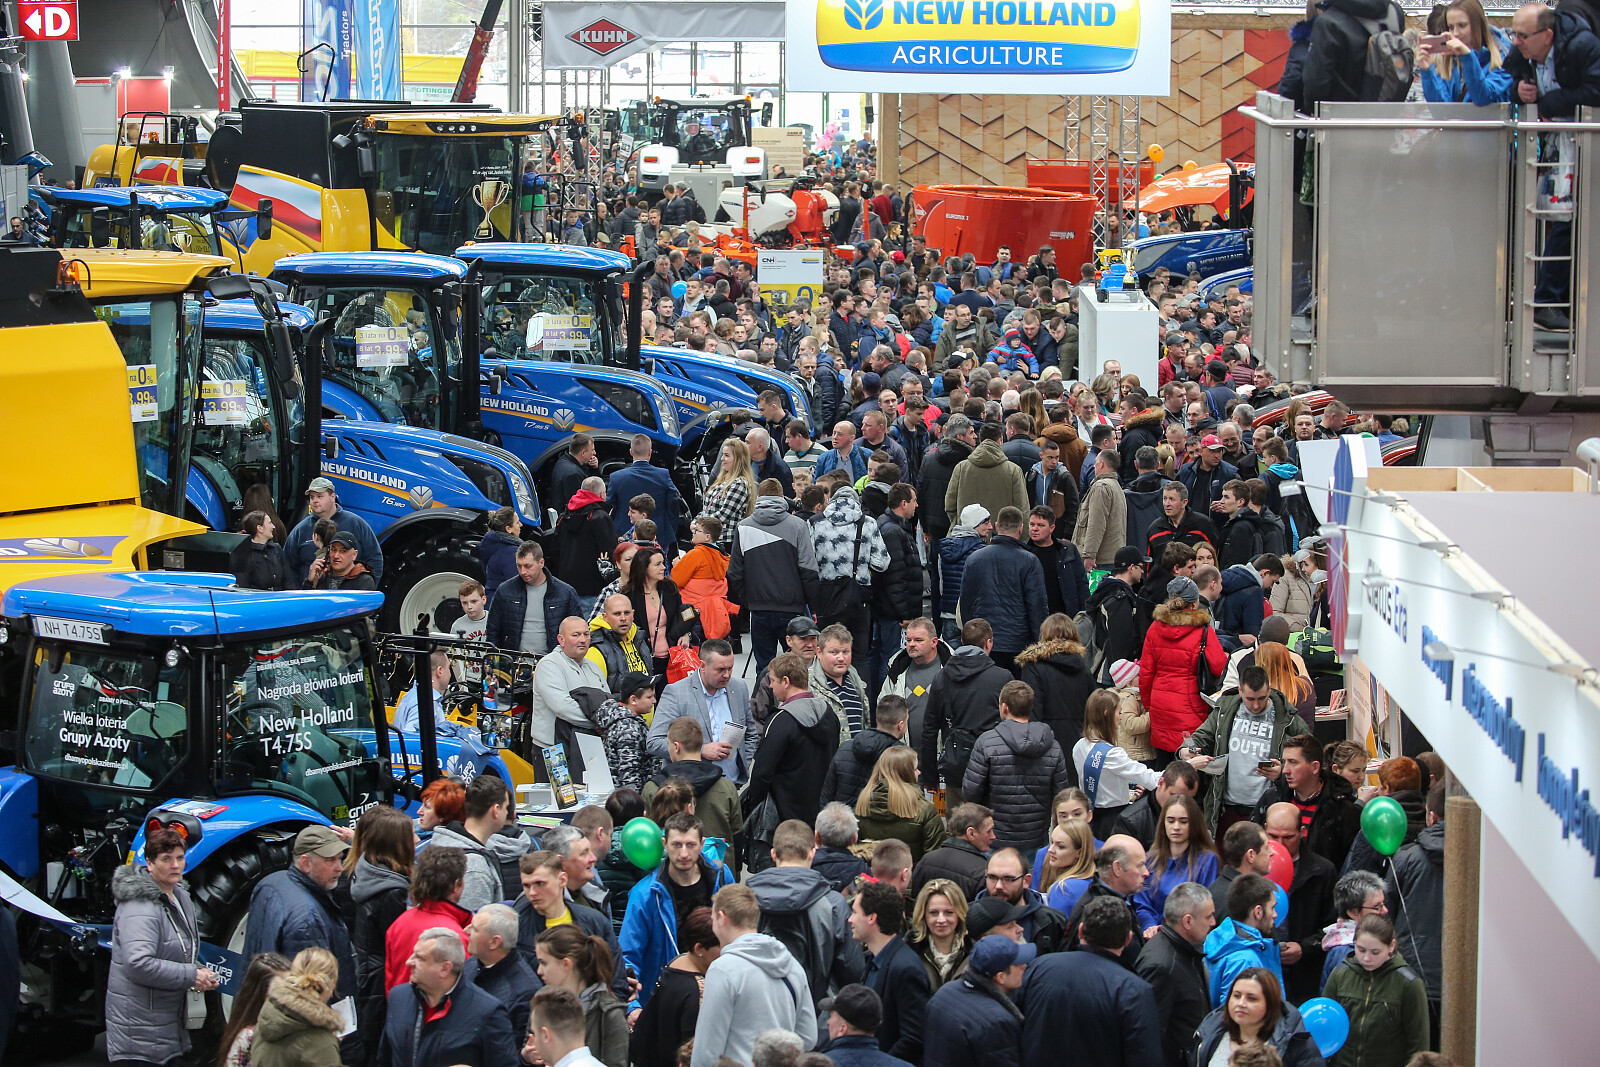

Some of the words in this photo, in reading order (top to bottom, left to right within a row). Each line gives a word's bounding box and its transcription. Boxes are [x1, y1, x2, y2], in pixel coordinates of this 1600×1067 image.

[44, 6, 70, 37] D
[893, 0, 965, 25] NEW
[972, 0, 1117, 27] HOLLAND
[340, 10, 352, 60] Tractors
[579, 31, 628, 43] KUHN
[891, 46, 1064, 66] AGRICULTURE
[572, 315, 587, 327] 0%
[388, 328, 404, 340] 0%
[129, 374, 137, 382] na
[138, 367, 154, 385] 0%
[223, 382, 242, 396] 0%
[664, 383, 707, 405] OLLAND
[208, 401, 244, 413] 3.99%
[500, 400, 549, 417] HOLLAND
[321, 461, 347, 476] NEW
[350, 467, 407, 490] HOLLAND
[43, 621, 61, 636] NH
[62, 623, 101, 641] T4.75S
[257, 684, 301, 701] Nagroda
[303, 676, 338, 695] główna
[339, 668, 364, 685] loterii
[63, 709, 94, 726] Wielka
[96, 717, 127, 730] loteria
[259, 715, 297, 735] New
[301, 702, 354, 728] Holland
[1233, 718, 1274, 739] TREET
[59, 728, 92, 748] Grupy
[94, 732, 131, 752] Azoty
[260, 731, 313, 757] T4.75S
[1229, 737, 1271, 758] OUTH
